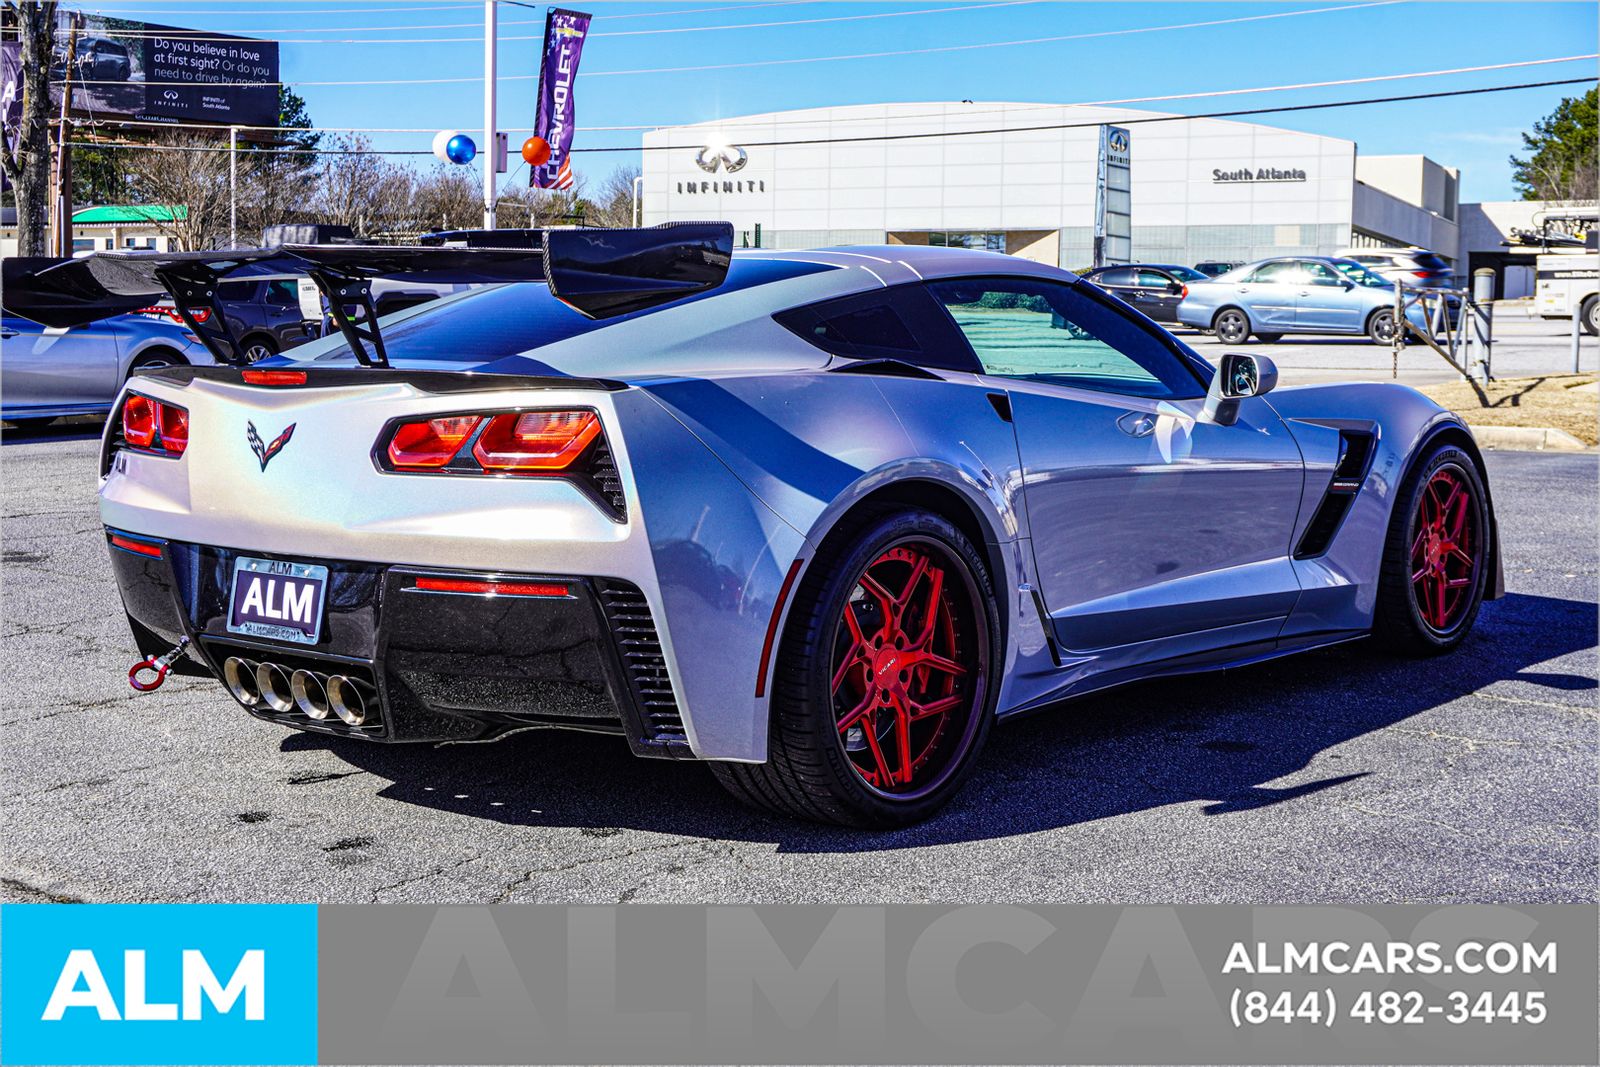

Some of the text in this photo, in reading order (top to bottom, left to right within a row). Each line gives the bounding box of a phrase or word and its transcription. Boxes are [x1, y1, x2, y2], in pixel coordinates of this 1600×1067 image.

[154, 37, 260, 61] Do you believe in love
[154, 52, 270, 76] at first sight? Or do you
[154, 68, 180, 79] need
[182, 70, 193, 80] to
[195, 71, 220, 83] drive
[221, 73, 234, 87] by
[154, 100, 189, 109] INFINITI
[547, 44, 571, 180] CHEVROLET
[1212, 167, 1307, 181] South Atlanta
[677, 180, 765, 195] INFINITI
[269, 561, 293, 576] ALM
[240, 577, 315, 624] ALM
